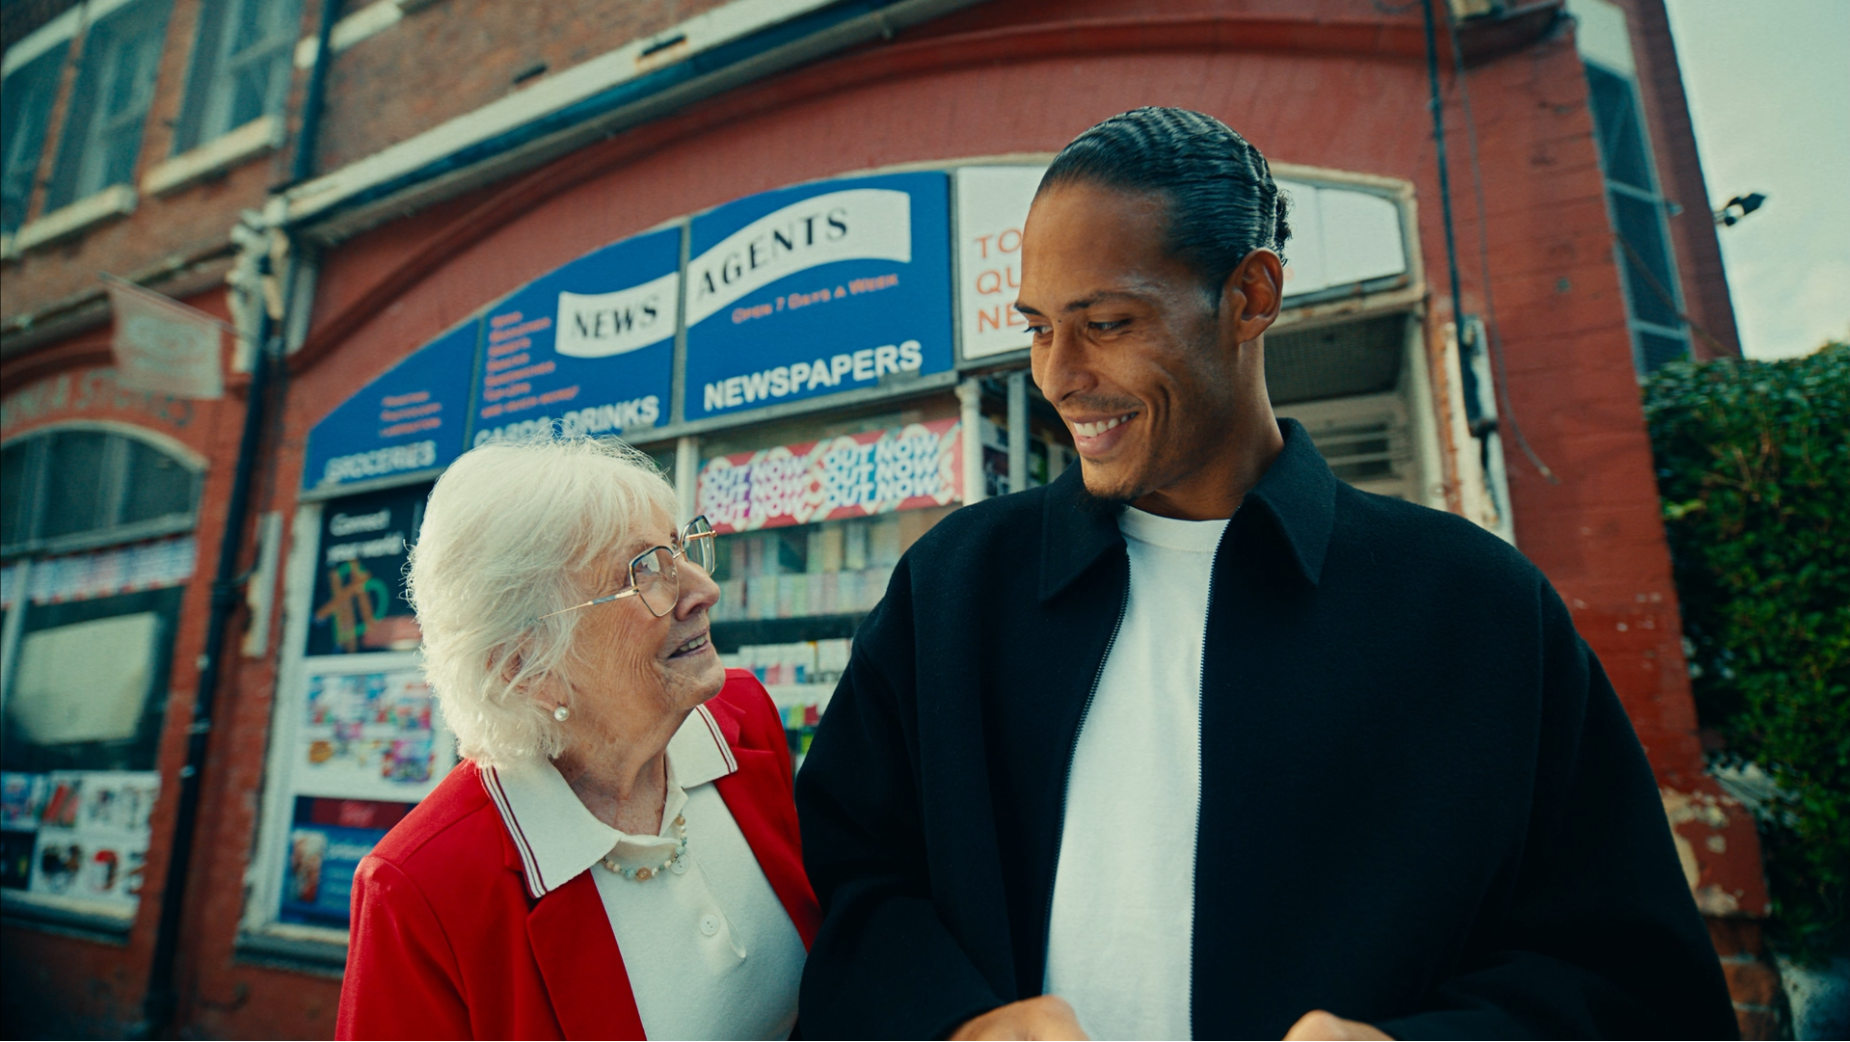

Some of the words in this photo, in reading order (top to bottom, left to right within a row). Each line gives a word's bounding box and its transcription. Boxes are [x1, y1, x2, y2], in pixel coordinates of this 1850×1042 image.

[697, 206, 850, 298] AGENTS
[571, 295, 658, 340] NEWS
[776, 296, 786, 312] 7
[704, 340, 922, 412] NEWSPAPERS
[562, 394, 660, 438] DRINKS
[822, 443, 877, 472] OUT
[878, 433, 940, 462] NOW
[822, 461, 877, 490] OUT
[878, 452, 940, 481] NOW
[701, 464, 751, 491] OUT
[751, 456, 809, 484] NOW
[701, 482, 751, 509] OUT
[751, 474, 809, 502] NOW
[822, 479, 877, 509] OUT
[878, 470, 940, 501] NOW
[701, 499, 750, 526] OUT
[751, 491, 809, 519] NOW
